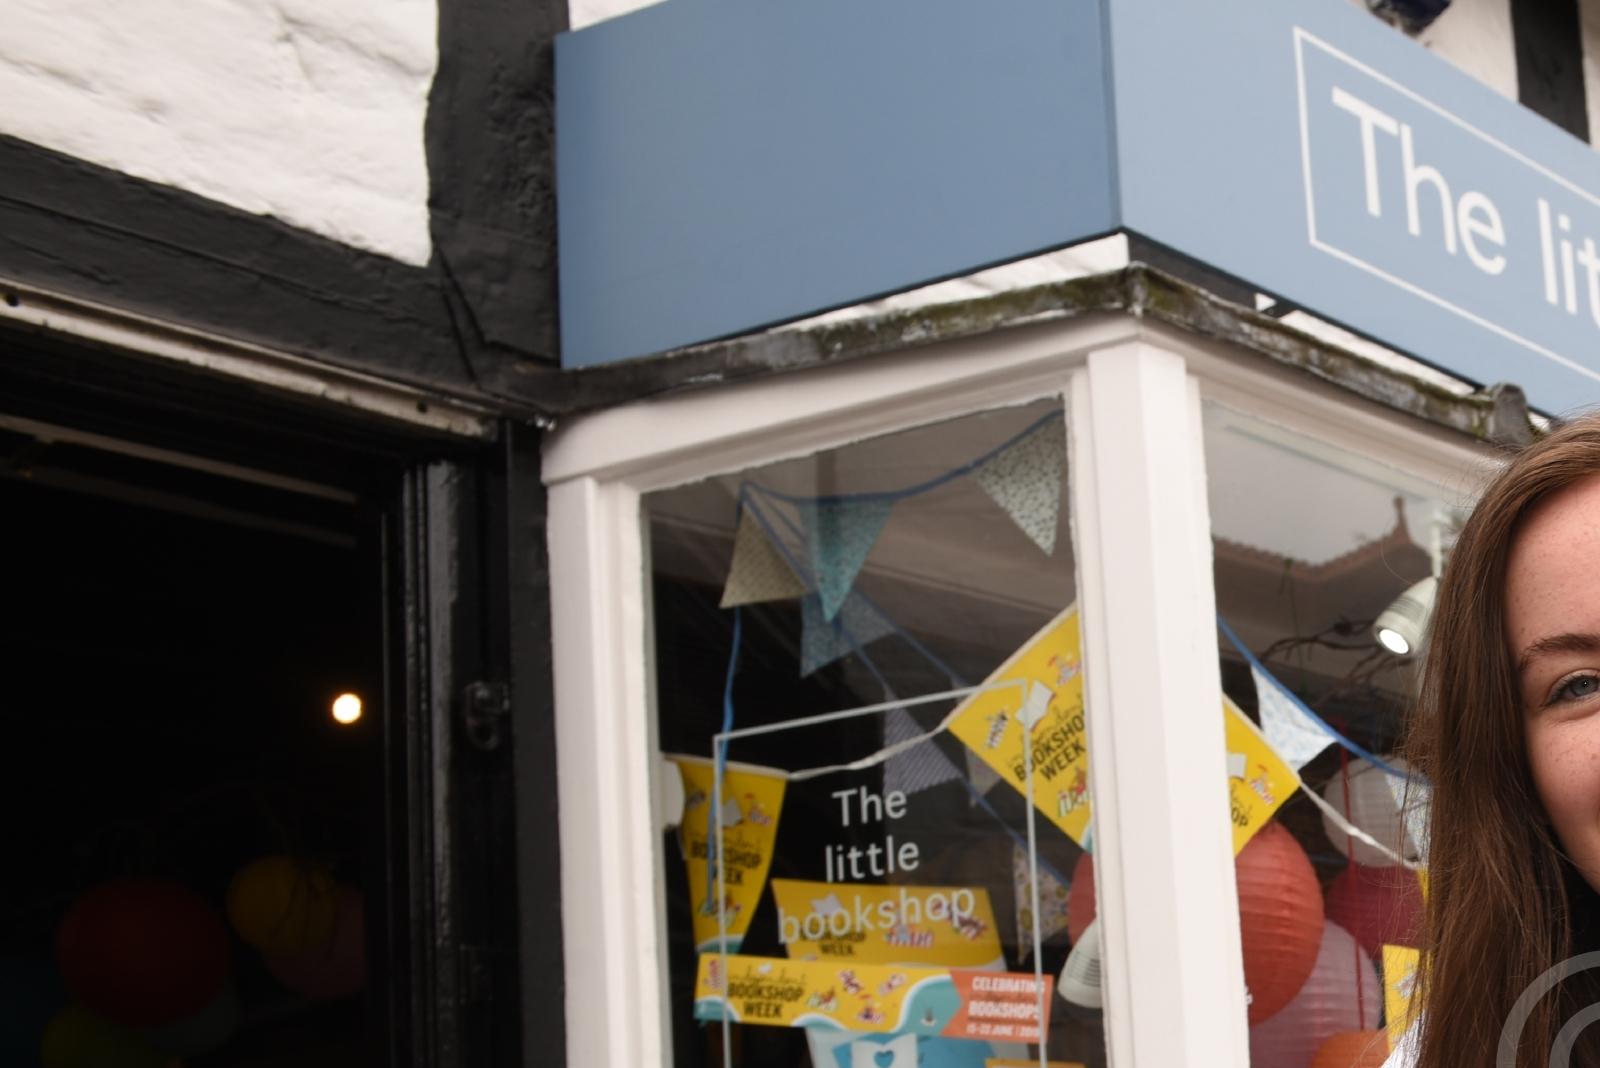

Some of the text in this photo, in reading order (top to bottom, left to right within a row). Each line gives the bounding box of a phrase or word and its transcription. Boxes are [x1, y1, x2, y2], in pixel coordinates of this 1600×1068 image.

[1332, 86, 1506, 275] The
[1013, 709, 1085, 782] BOOKSHO
[1040, 739, 1087, 781] WEEK
[832, 786, 907, 827] The
[826, 835, 920, 883] little
[778, 887, 976, 944] bookshop
[728, 982, 804, 1002] BOOKSHOP
[743, 1001, 783, 1018] WEEK
